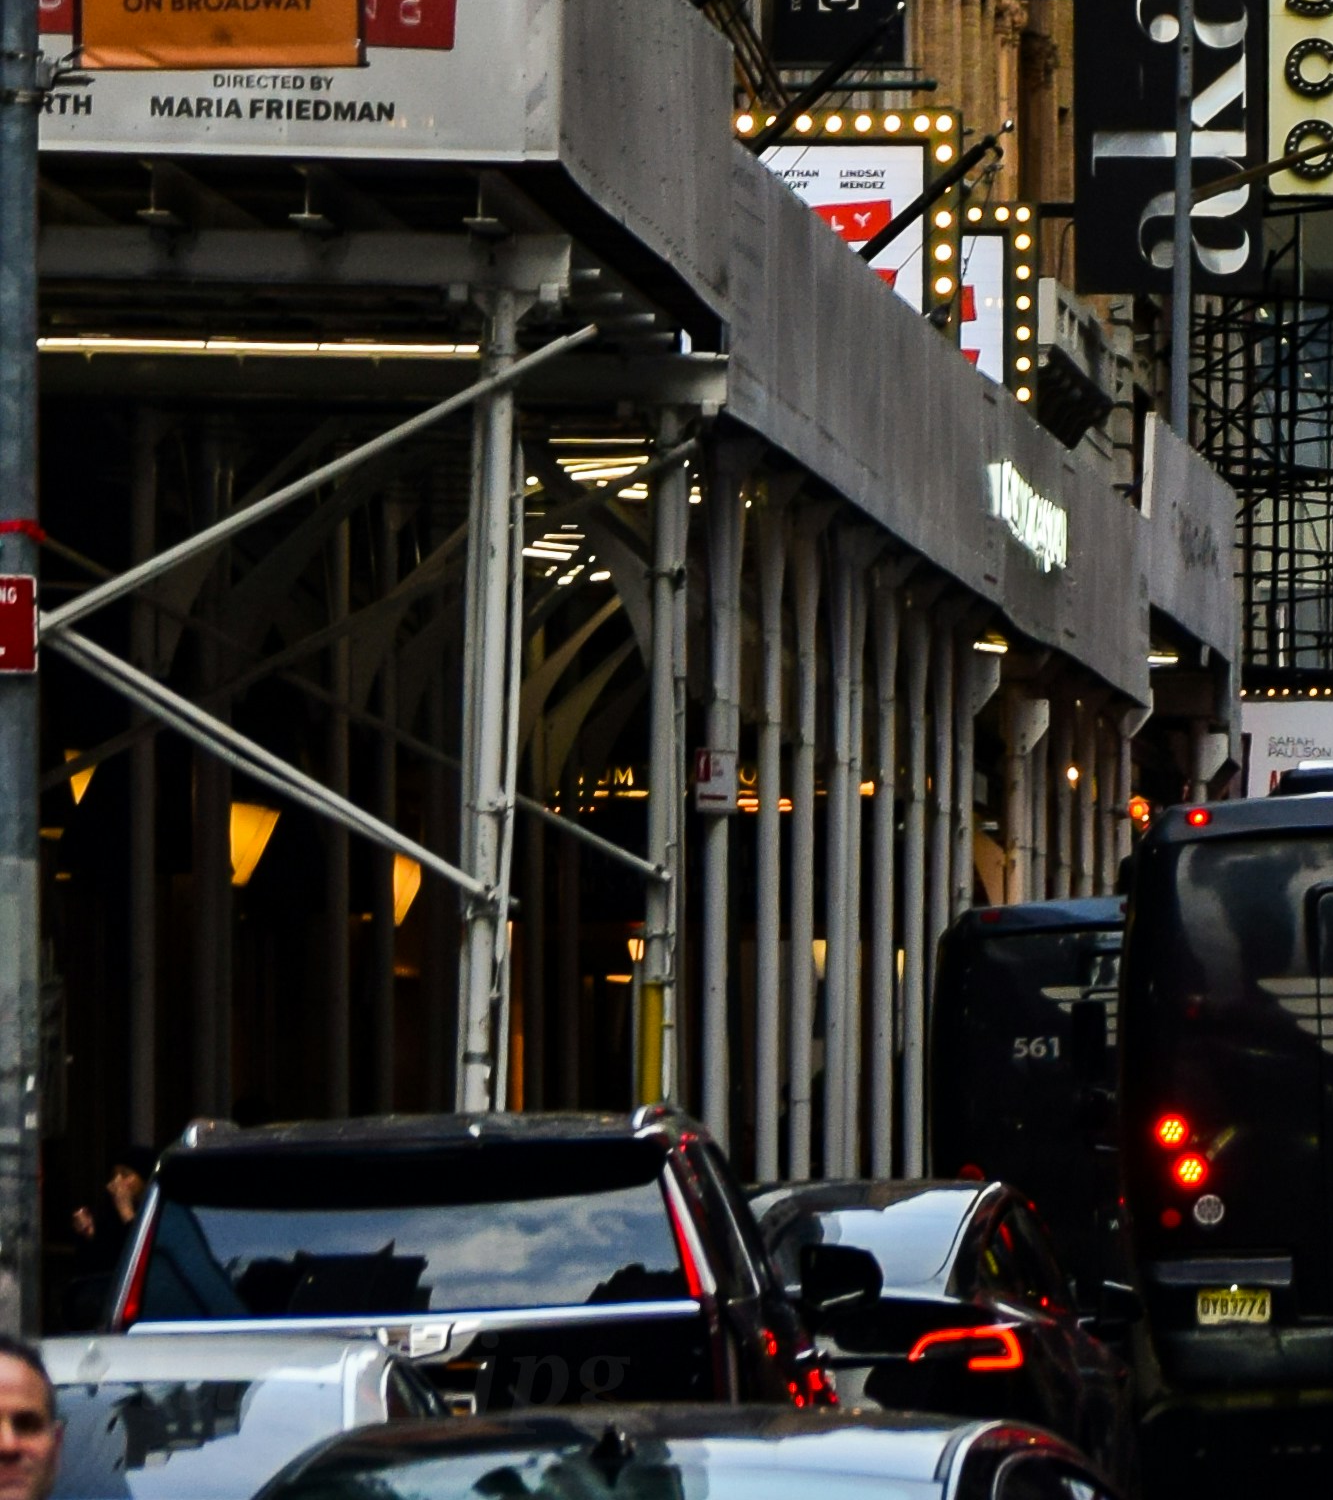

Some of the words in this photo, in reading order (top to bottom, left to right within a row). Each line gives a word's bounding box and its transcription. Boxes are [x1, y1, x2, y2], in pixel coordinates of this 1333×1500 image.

[212, 73, 305, 91] DIRECTED
[310, 75, 334, 92] BY
[150, 95, 242, 119] MARIA
[249, 96, 396, 122] FRIEDMAN
[839, 168, 887, 179] LINDSAY
[839, 181, 886, 190] MENDEZ
[1268, 736, 1315, 747] SARAH
[1267, 747, 1333, 759] PAULSON
[1012, 1036, 1062, 1059] 561
